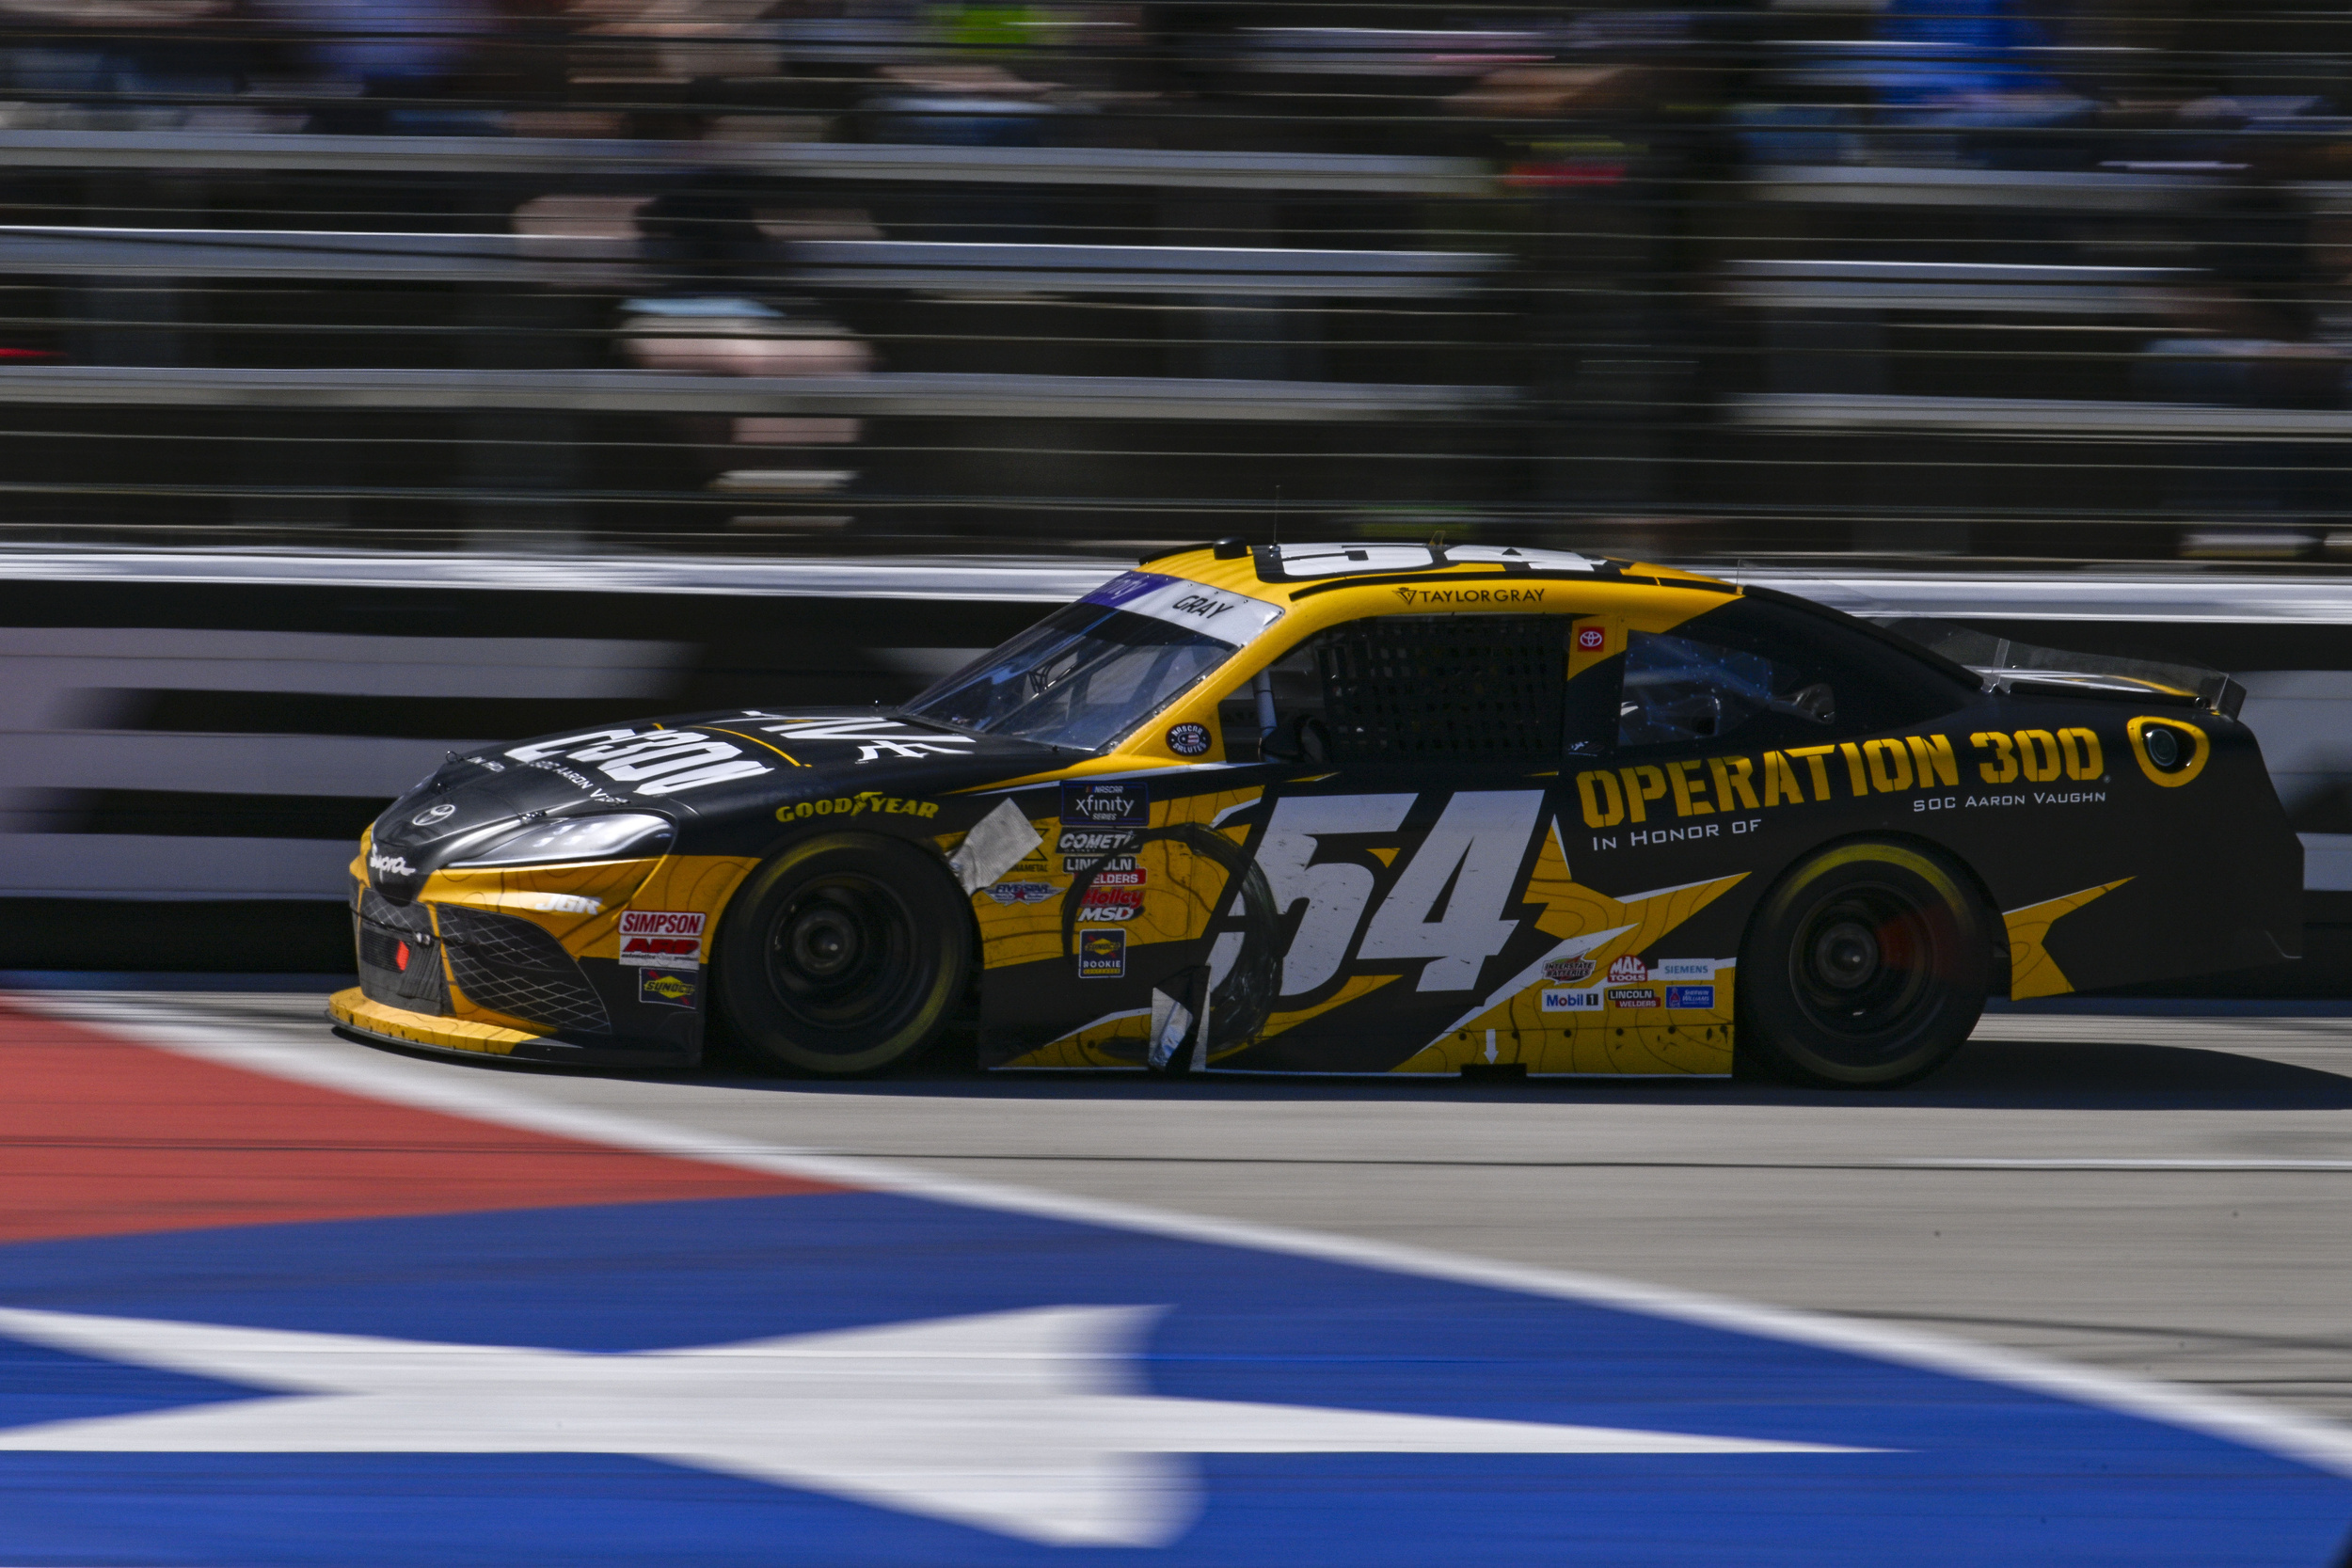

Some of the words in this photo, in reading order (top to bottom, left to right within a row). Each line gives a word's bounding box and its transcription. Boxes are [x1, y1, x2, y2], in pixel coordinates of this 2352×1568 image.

[1172, 595, 1234, 618] GRAY
[1171, 725, 1203, 736] NASCAR
[1172, 742, 1207, 753] SALUTES
[1576, 734, 1960, 829] OPERATION
[1970, 727, 2105, 784] 300
[775, 792, 940, 823] GOODYEAR
[1075, 795, 1135, 817] xfinity
[1914, 798, 1957, 812] SOC
[1092, 813, 1117, 821] SERIES
[1592, 835, 1618, 851] IN
[1630, 824, 1720, 847] HONOR
[1732, 818, 1762, 834] OF
[1066, 858, 1132, 871] LINLN
[1092, 873, 1138, 884] ELDERS
[1081, 887, 1145, 910] Holley
[1205, 789, 1546, 997] 54
[1078, 907, 1135, 922] MSD
[623, 913, 702, 935] SIMPSON
[623, 938, 700, 956] ARP
[1083, 959, 1121, 969] ROOKIE
[1546, 961, 1595, 971] INTERSTATE
[1610, 956, 1645, 975] MAC
[1664, 965, 1708, 974] SIEMENS
[1547, 969, 1590, 977] BATTERIES
[1610, 974, 1645, 982] TOOLS
[1546, 994, 1584, 1006] Mobil
[1610, 990, 1653, 999] LINCOLN
